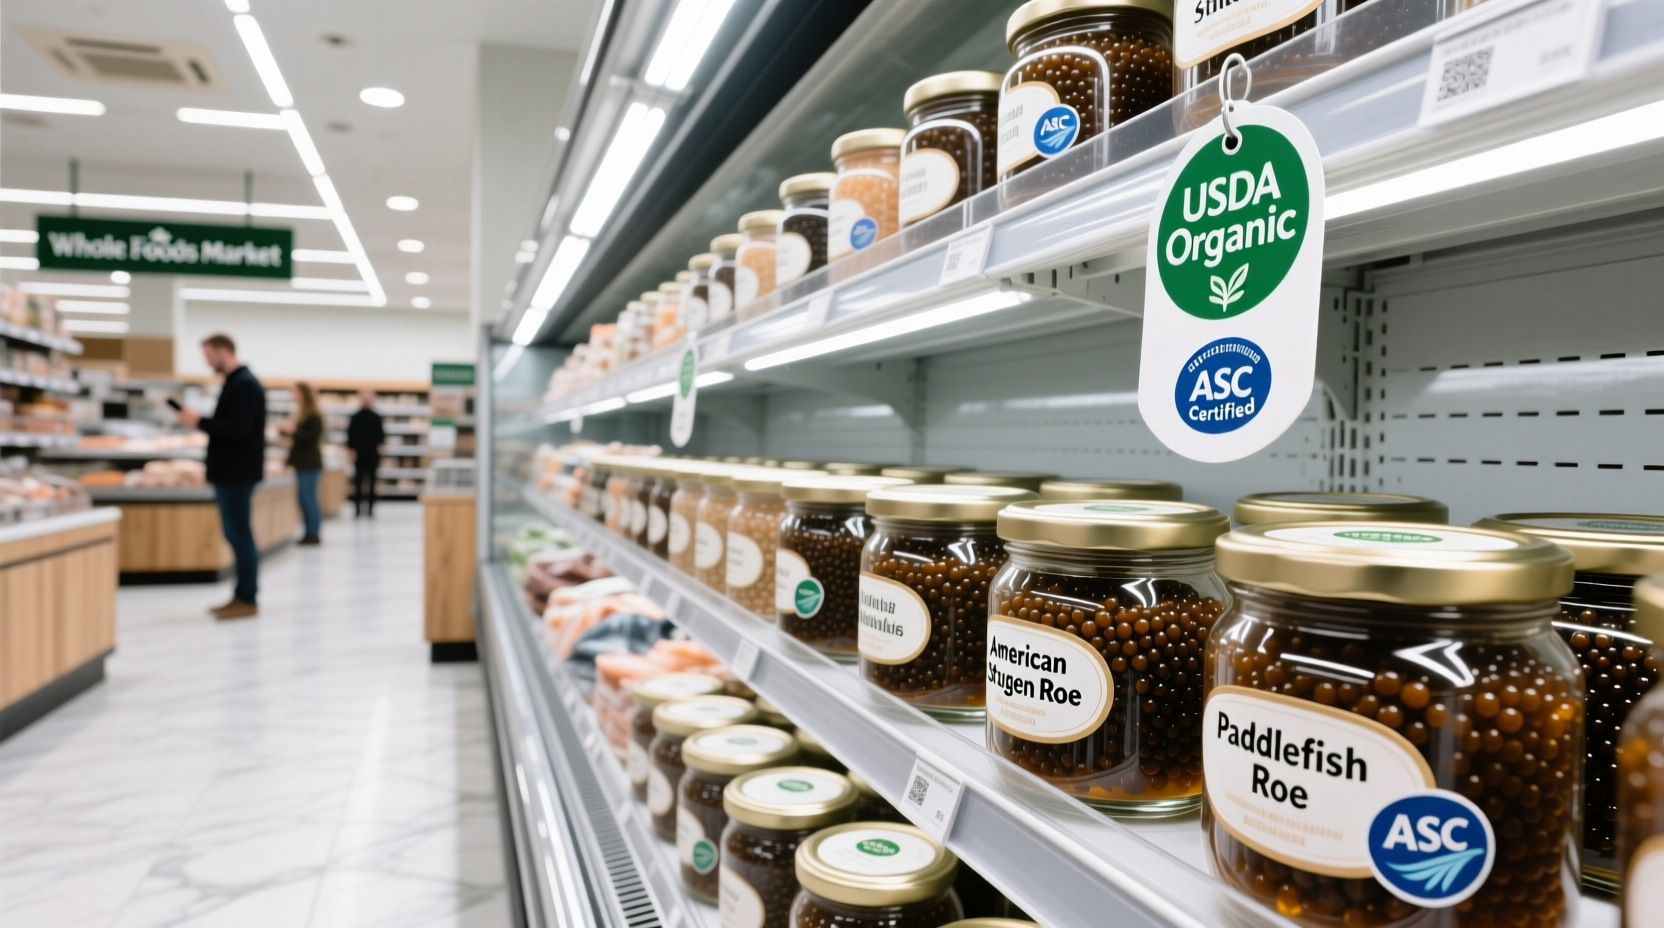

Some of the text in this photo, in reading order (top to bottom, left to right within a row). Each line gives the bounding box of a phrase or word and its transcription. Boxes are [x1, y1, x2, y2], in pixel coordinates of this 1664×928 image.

[1183, 161, 1281, 222] USDA
[48, 231, 282, 267] Whole Foods Market
[1165, 205, 1297, 268] Organic
[1189, 365, 1254, 402] ASC
[1189, 396, 1255, 422] Certified
[990, 635, 1067, 675] American
[1039, 677, 1082, 706] Roe
[1217, 711, 1368, 782] Paddlefish
[1252, 763, 1308, 809] Roe
[1381, 813, 1470, 853] ASC
